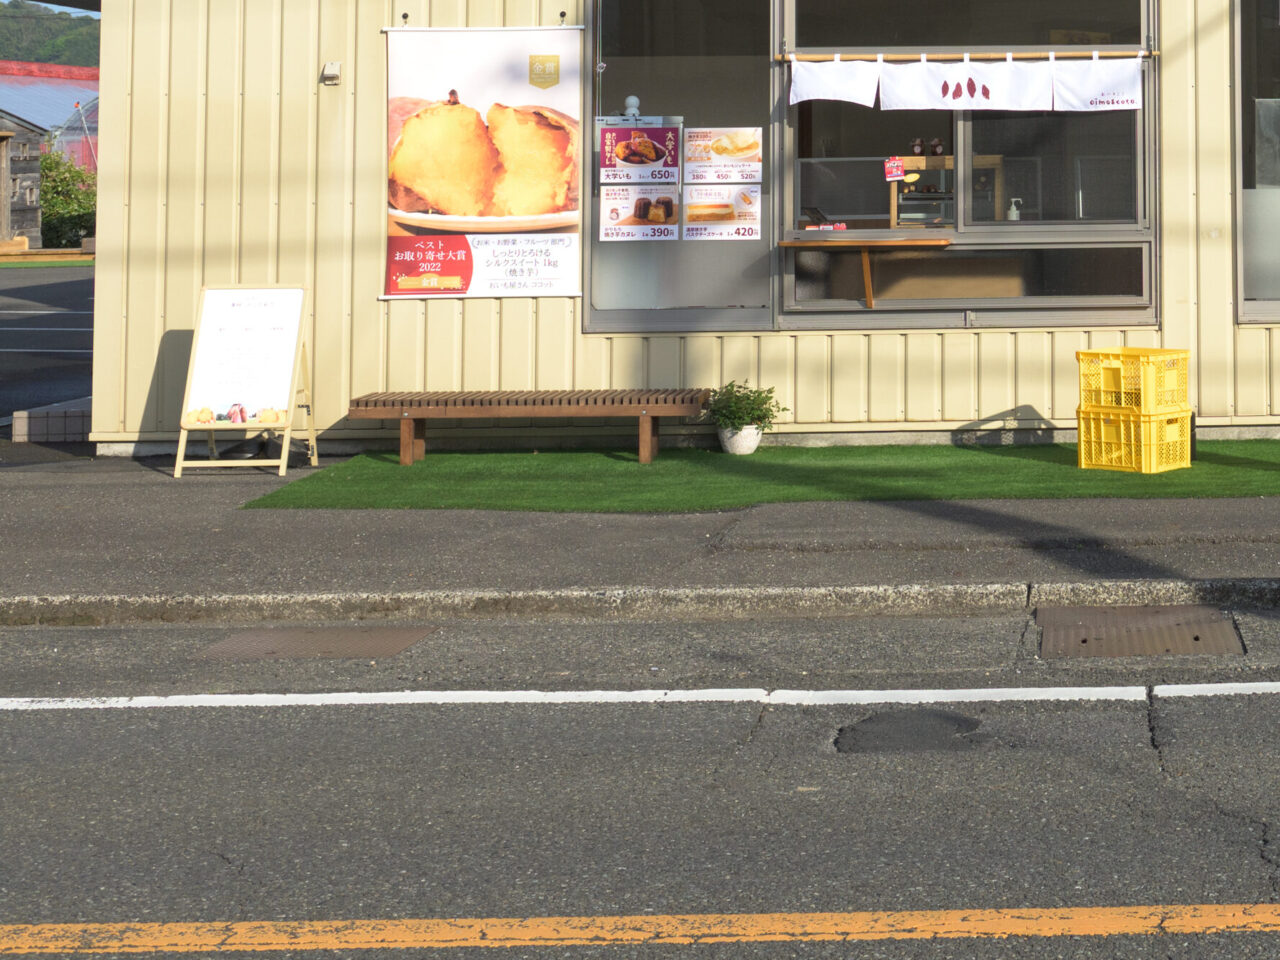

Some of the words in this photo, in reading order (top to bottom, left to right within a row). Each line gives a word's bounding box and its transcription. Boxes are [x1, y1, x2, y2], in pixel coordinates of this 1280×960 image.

[665, 131, 675, 164] 大学いも
[415, 240, 444, 249] ベスト
[394, 250, 467, 261] お取り寄せ大賞
[419, 262, 441, 272] 2022
